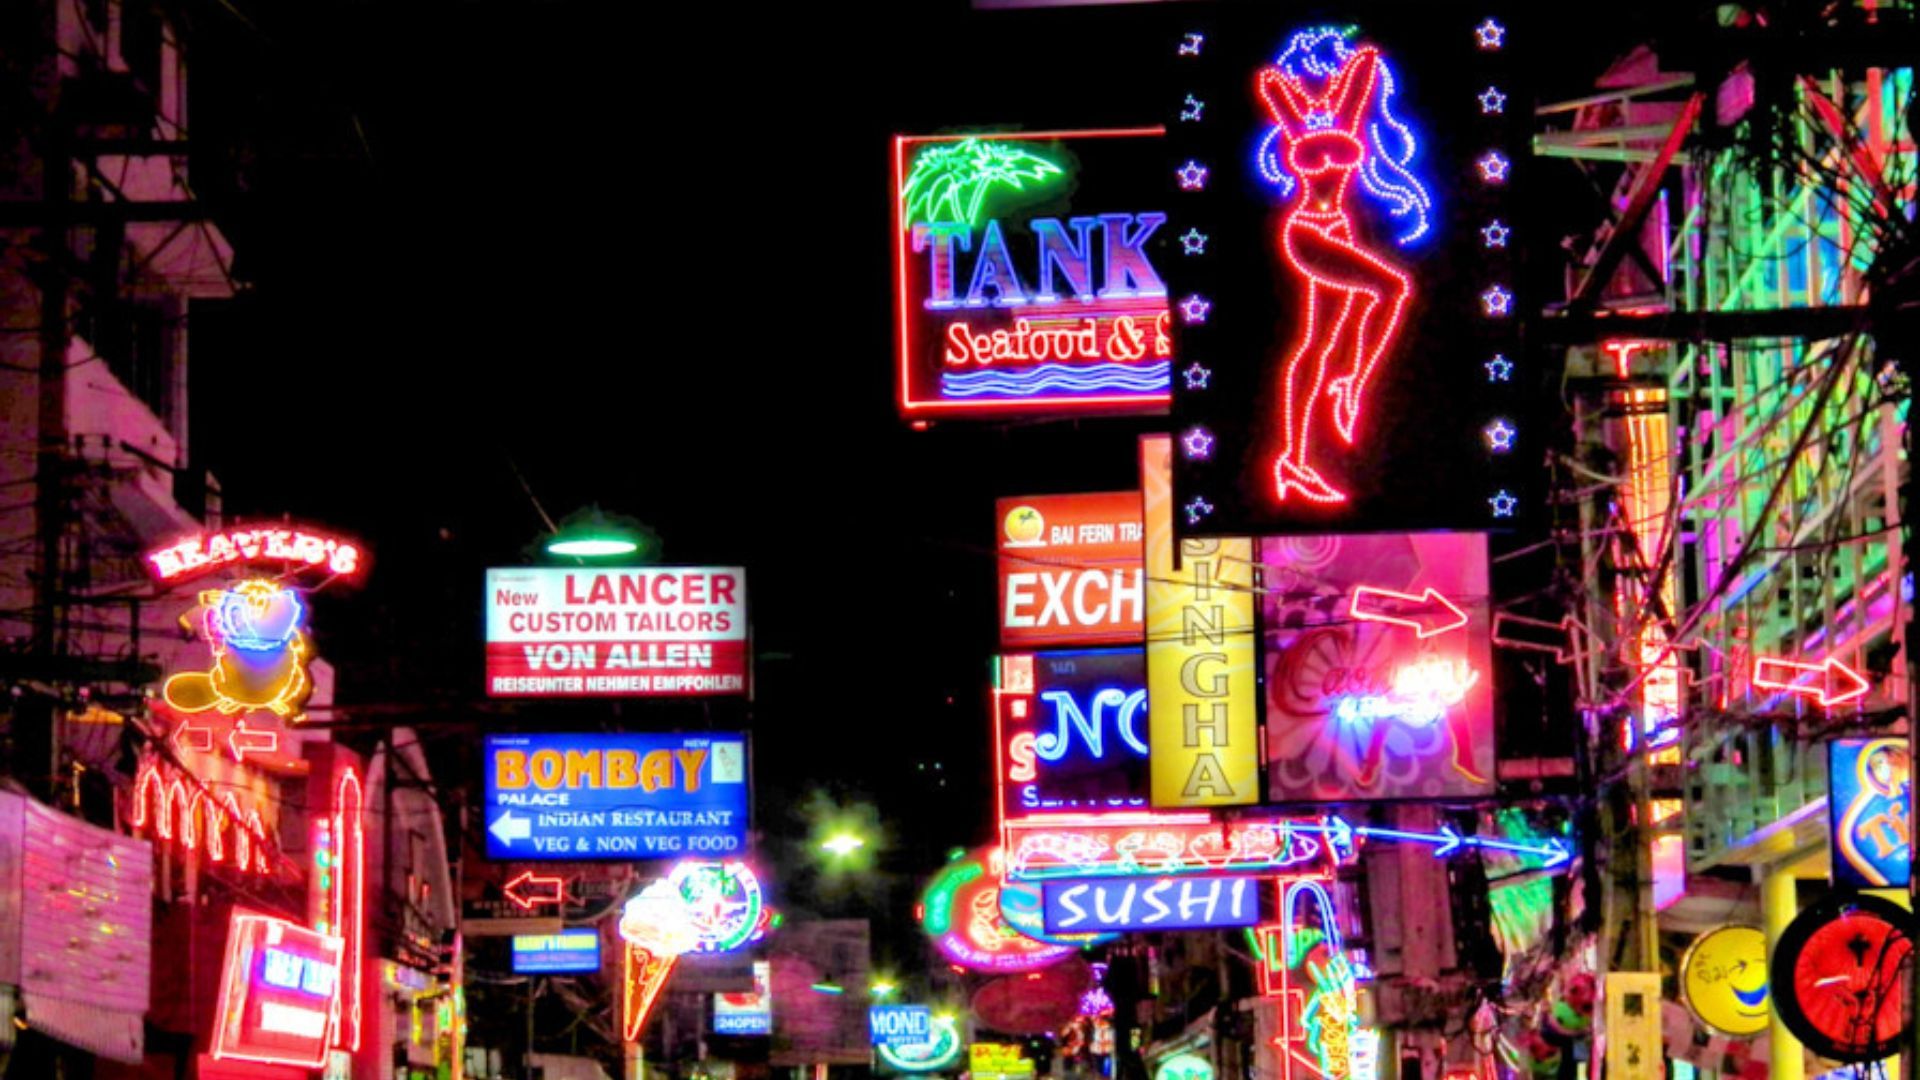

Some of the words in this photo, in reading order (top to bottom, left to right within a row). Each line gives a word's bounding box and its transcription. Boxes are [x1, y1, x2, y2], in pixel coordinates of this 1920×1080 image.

[912, 212, 1167, 310] TANK
[945, 317, 1101, 364] Seafood
[1107, 315, 1146, 361] &
[1051, 525, 1075, 546] BAI
[1078, 523, 1115, 545] FERN
[496, 589, 539, 606] New
[565, 573, 737, 605] LANCER
[1004, 568, 1143, 628] EXCH
[509, 611, 617, 633] CUSTOM
[625, 611, 732, 633] TAILORS
[523, 644, 597, 670] VON
[605, 643, 712, 669] ALLEN
[492, 677, 583, 693] REISEUNTER
[586, 676, 650, 692] NEHMEN
[653, 675, 742, 691] EMPFOHLEN
[683, 739, 710, 749] NEW
[495, 748, 707, 794] BOMBAY
[497, 792, 570, 806] PALACE
[538, 812, 606, 828] INDIAN
[611, 810, 732, 827] RESTAURANT
[533, 836, 569, 852] VEG
[575, 836, 590, 851] &
[596, 836, 638, 851] NON
[645, 836, 682, 851] VEG
[688, 835, 739, 851] FOOD
[1056, 878, 1247, 927] SUSHI
